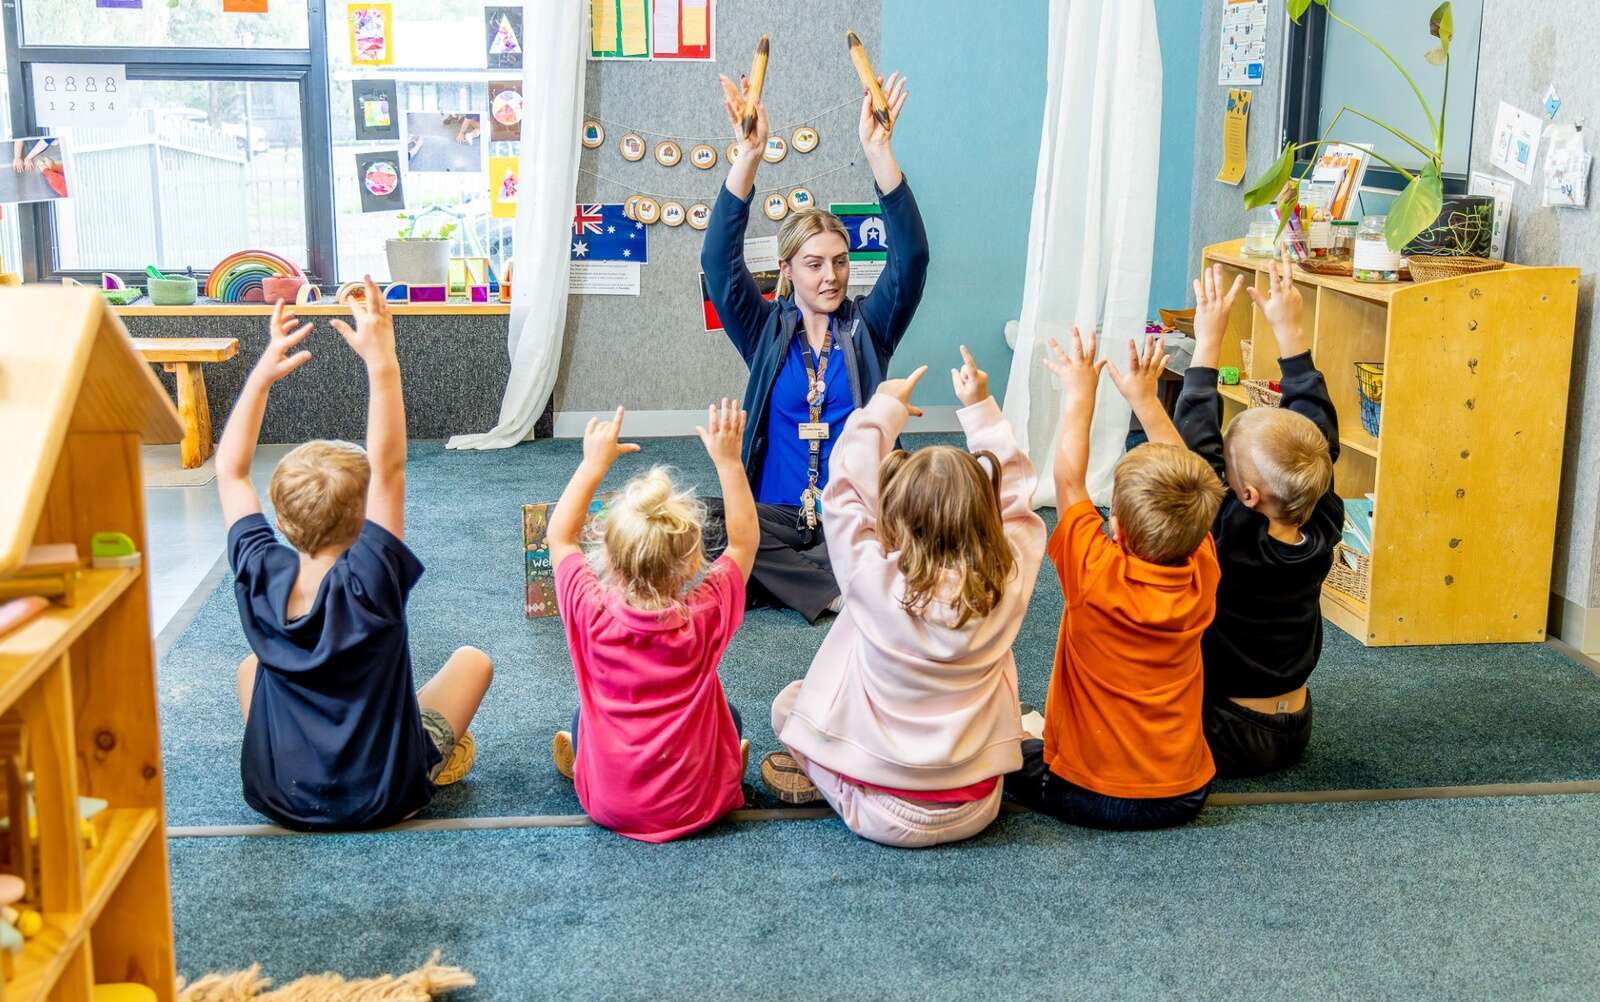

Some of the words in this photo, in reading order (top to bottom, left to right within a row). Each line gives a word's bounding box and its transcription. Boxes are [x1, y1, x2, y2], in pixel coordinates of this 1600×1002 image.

[49, 101, 56, 111] 1
[69, 101, 76, 111] 2
[89, 101, 96, 111] 3
[108, 102, 114, 111] 4
